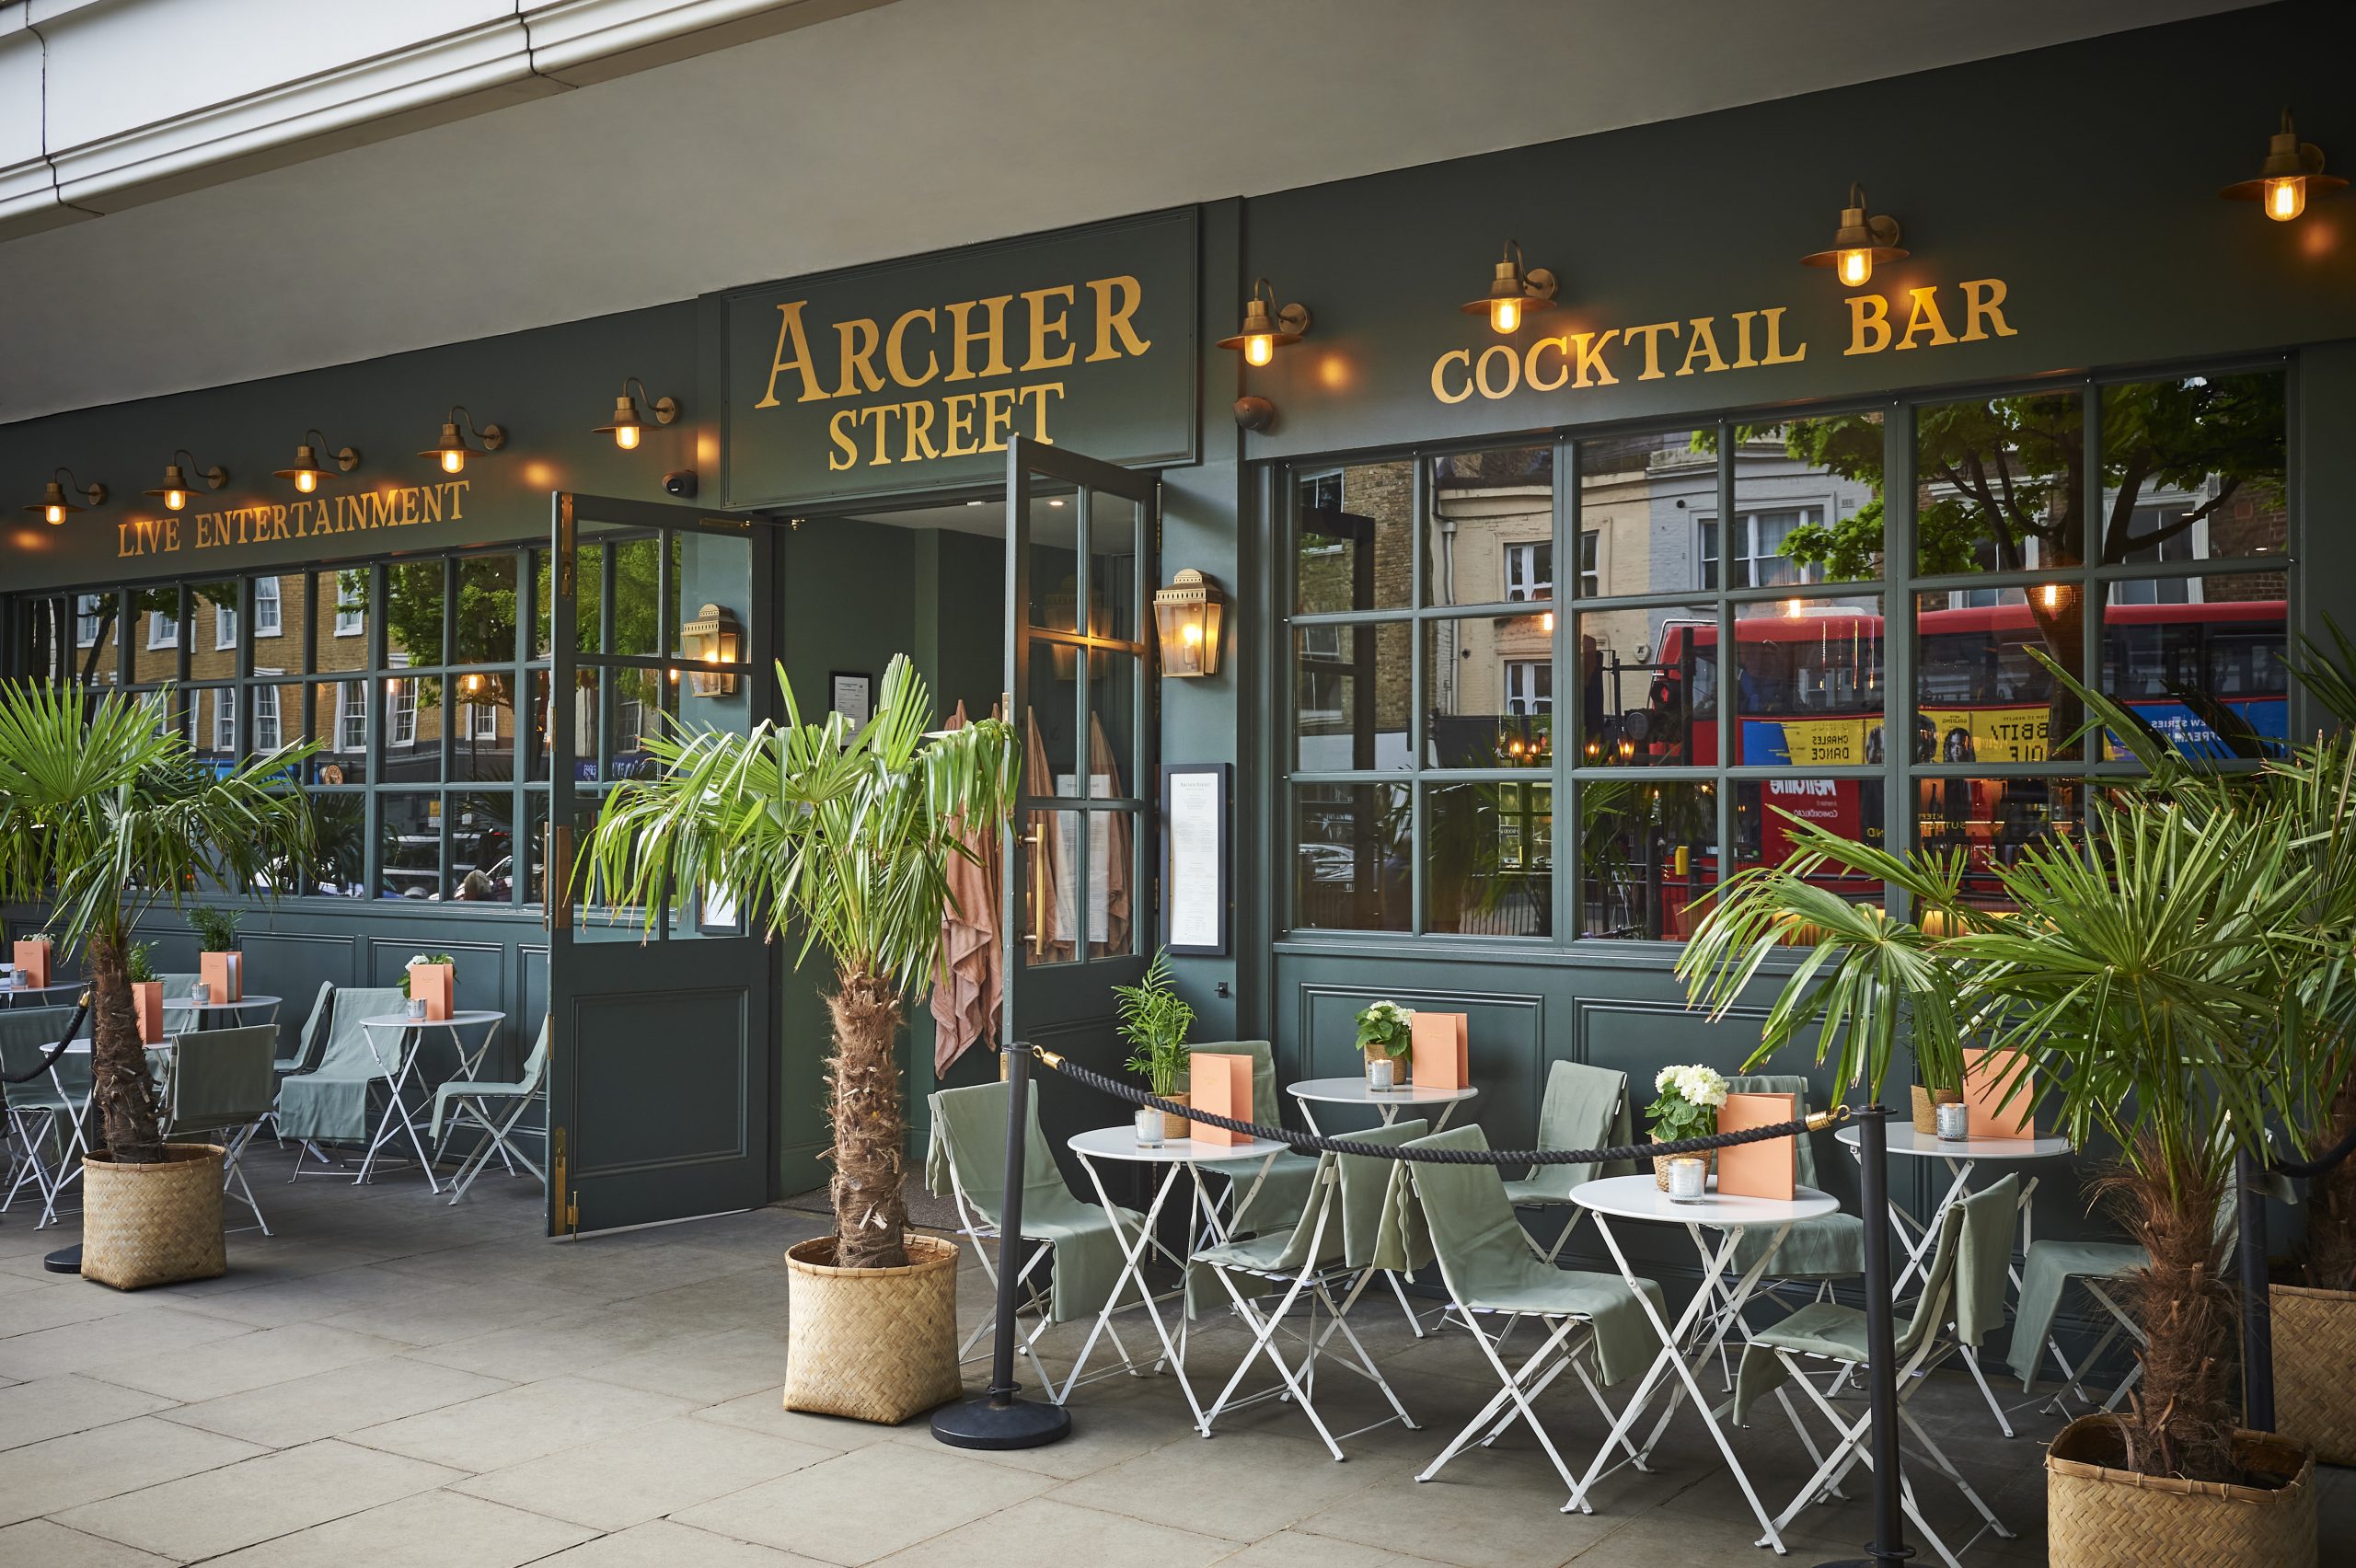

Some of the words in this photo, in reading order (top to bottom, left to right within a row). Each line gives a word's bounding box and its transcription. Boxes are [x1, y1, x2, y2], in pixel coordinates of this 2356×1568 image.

[755, 275, 1151, 409] ARCHER
[1430, 306, 1807, 404] COCKTAIL
[1843, 278, 2017, 356] BAR
[828, 382, 1065, 471] STREET
[118, 516, 180, 558] LIVE
[194, 480, 470, 549] ENTERTAINMENT
